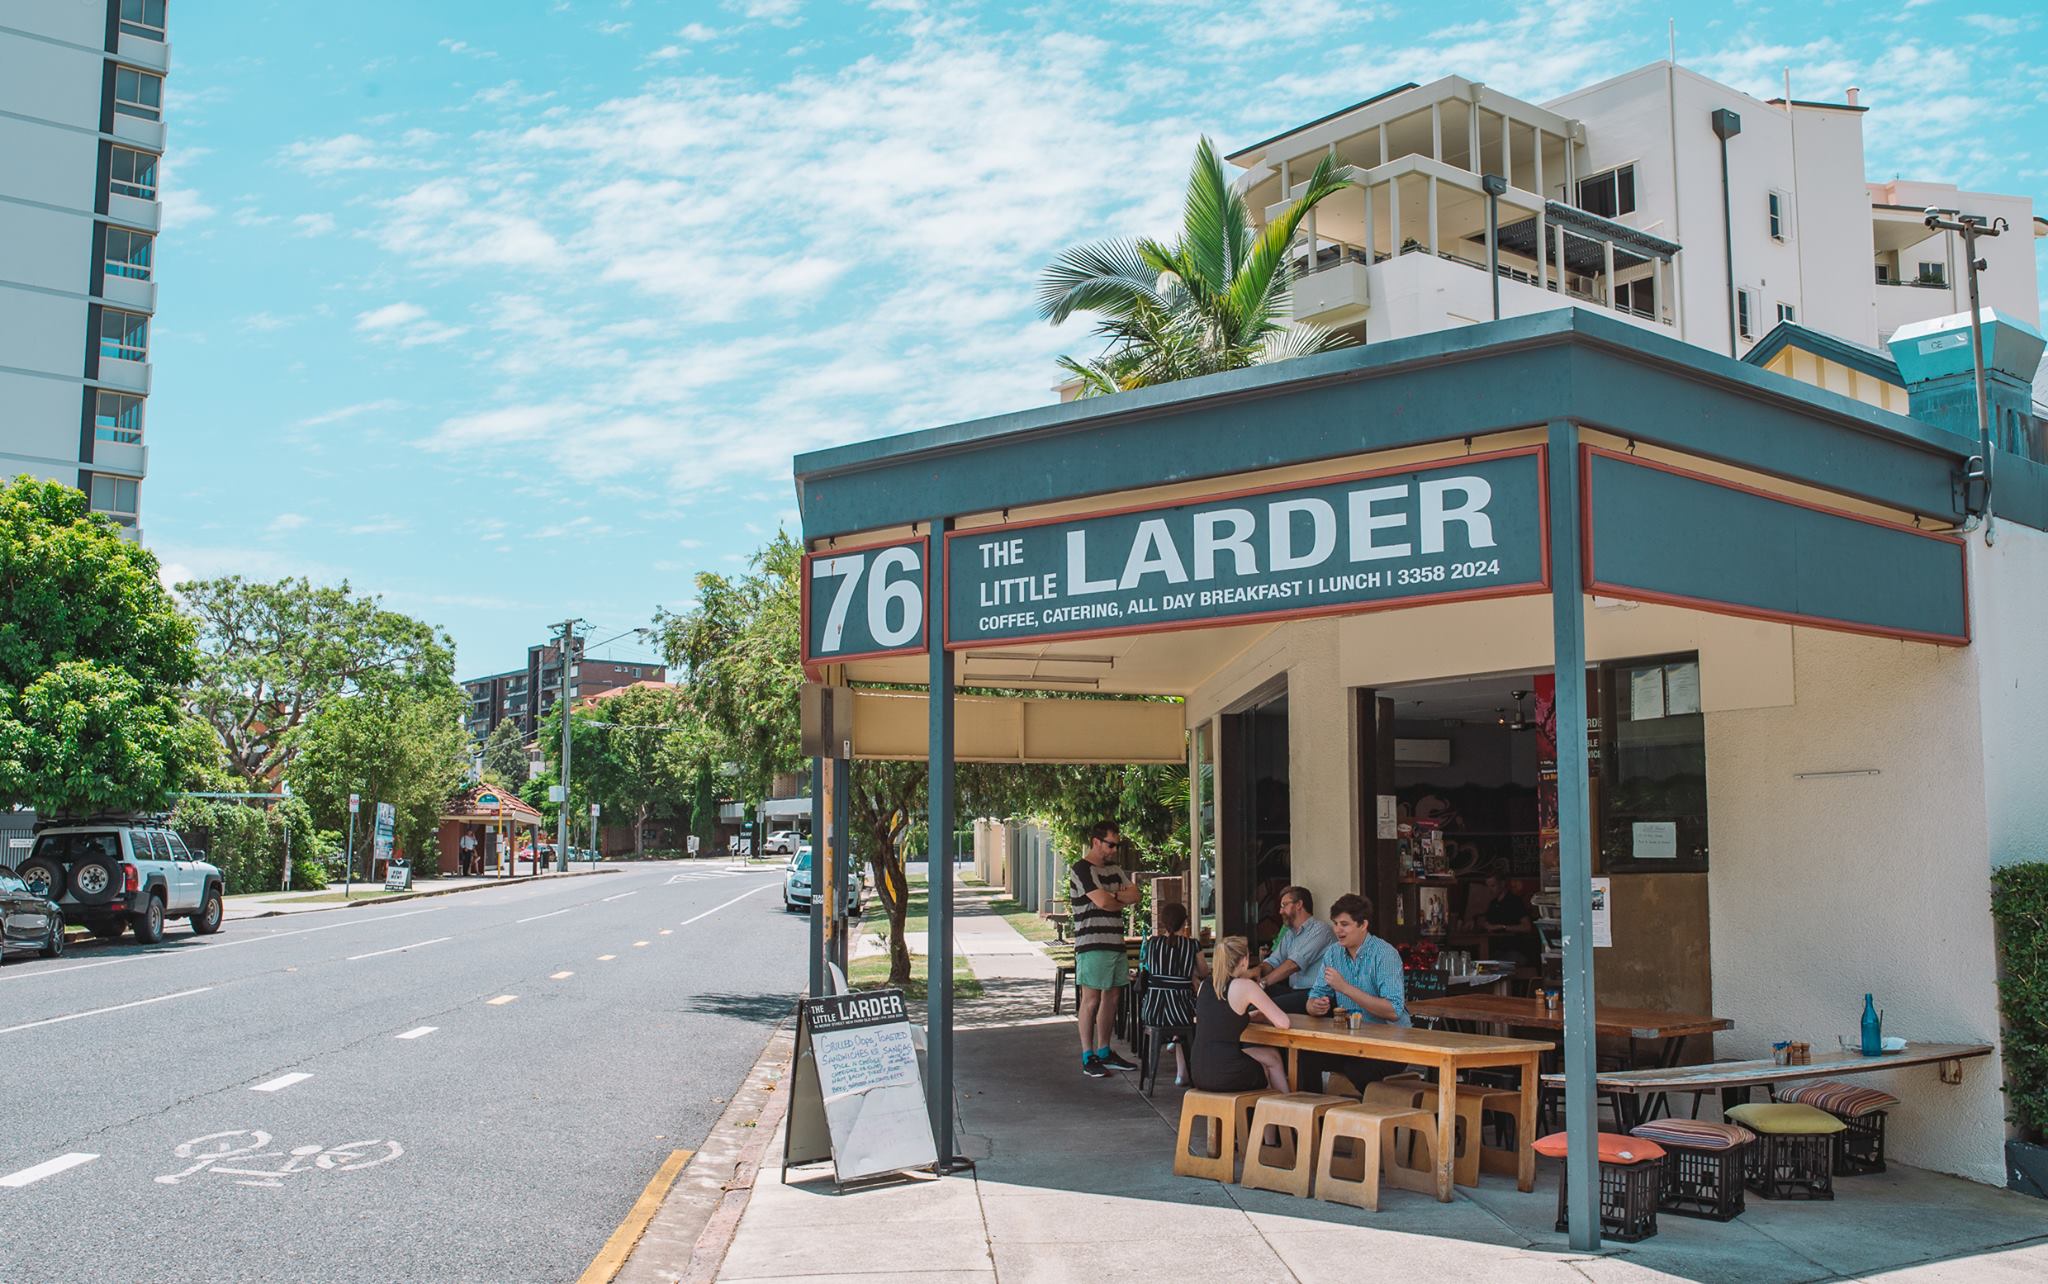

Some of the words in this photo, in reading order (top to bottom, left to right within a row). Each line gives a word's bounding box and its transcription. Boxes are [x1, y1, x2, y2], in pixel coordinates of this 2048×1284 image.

[1067, 476, 1498, 596] LARDER
[979, 539, 1024, 568] THE
[813, 547, 922, 652] 76
[979, 612, 1039, 631] COFFEE,
[1042, 602, 1123, 624] CATERING,
[1127, 598, 1158, 614] ALL
[1163, 593, 1195, 610] DAY
[1200, 581, 1302, 606] BREAKFAST
[1319, 572, 1380, 593] LUNCH
[1397, 565, 1445, 585] 3358
[1450, 559, 1500, 580] 2024
[980, 573, 1057, 607] LITTLE
[811, 1005, 824, 1014] THE
[812, 1013, 836, 1024] LITTLE
[838, 995, 903, 1021] LARDER
